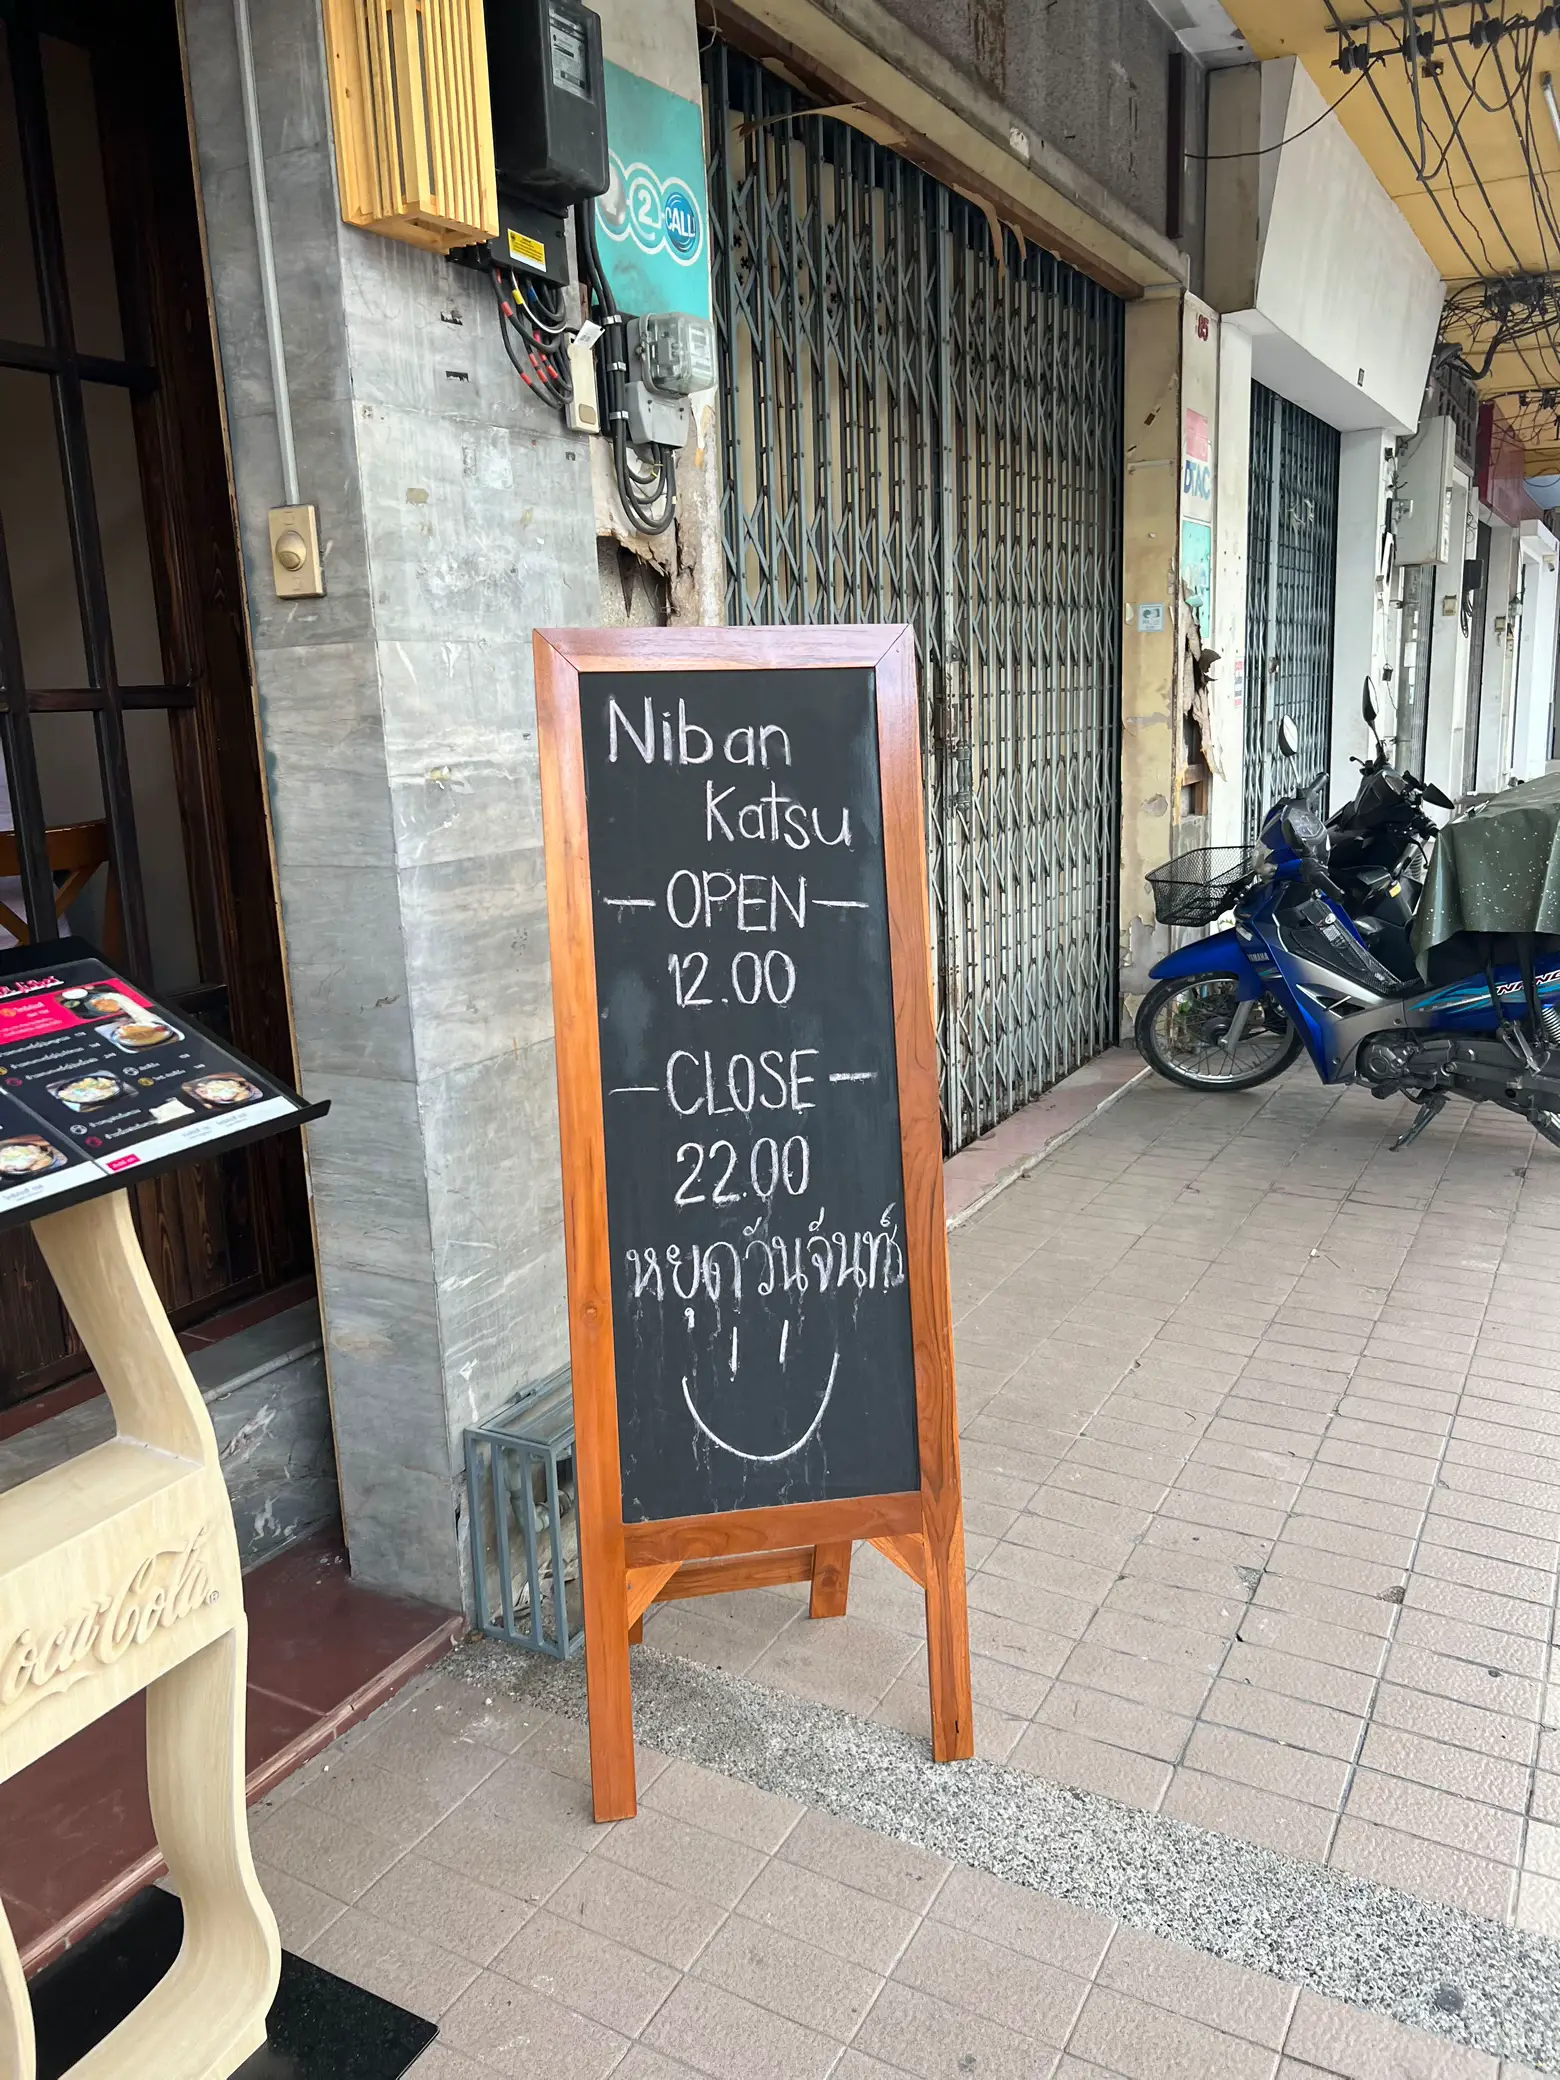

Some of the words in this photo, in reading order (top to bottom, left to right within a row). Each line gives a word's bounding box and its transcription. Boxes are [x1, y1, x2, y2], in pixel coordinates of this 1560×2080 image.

[608, 694, 792, 767] Niban
[706, 779, 853, 850] Katsu
[666, 868, 807, 933] OPEN
[667, 949, 797, 1008] 12.00
[666, 1048, 820, 1116] CLOSE
[674, 1135, 810, 1206] 22.00
